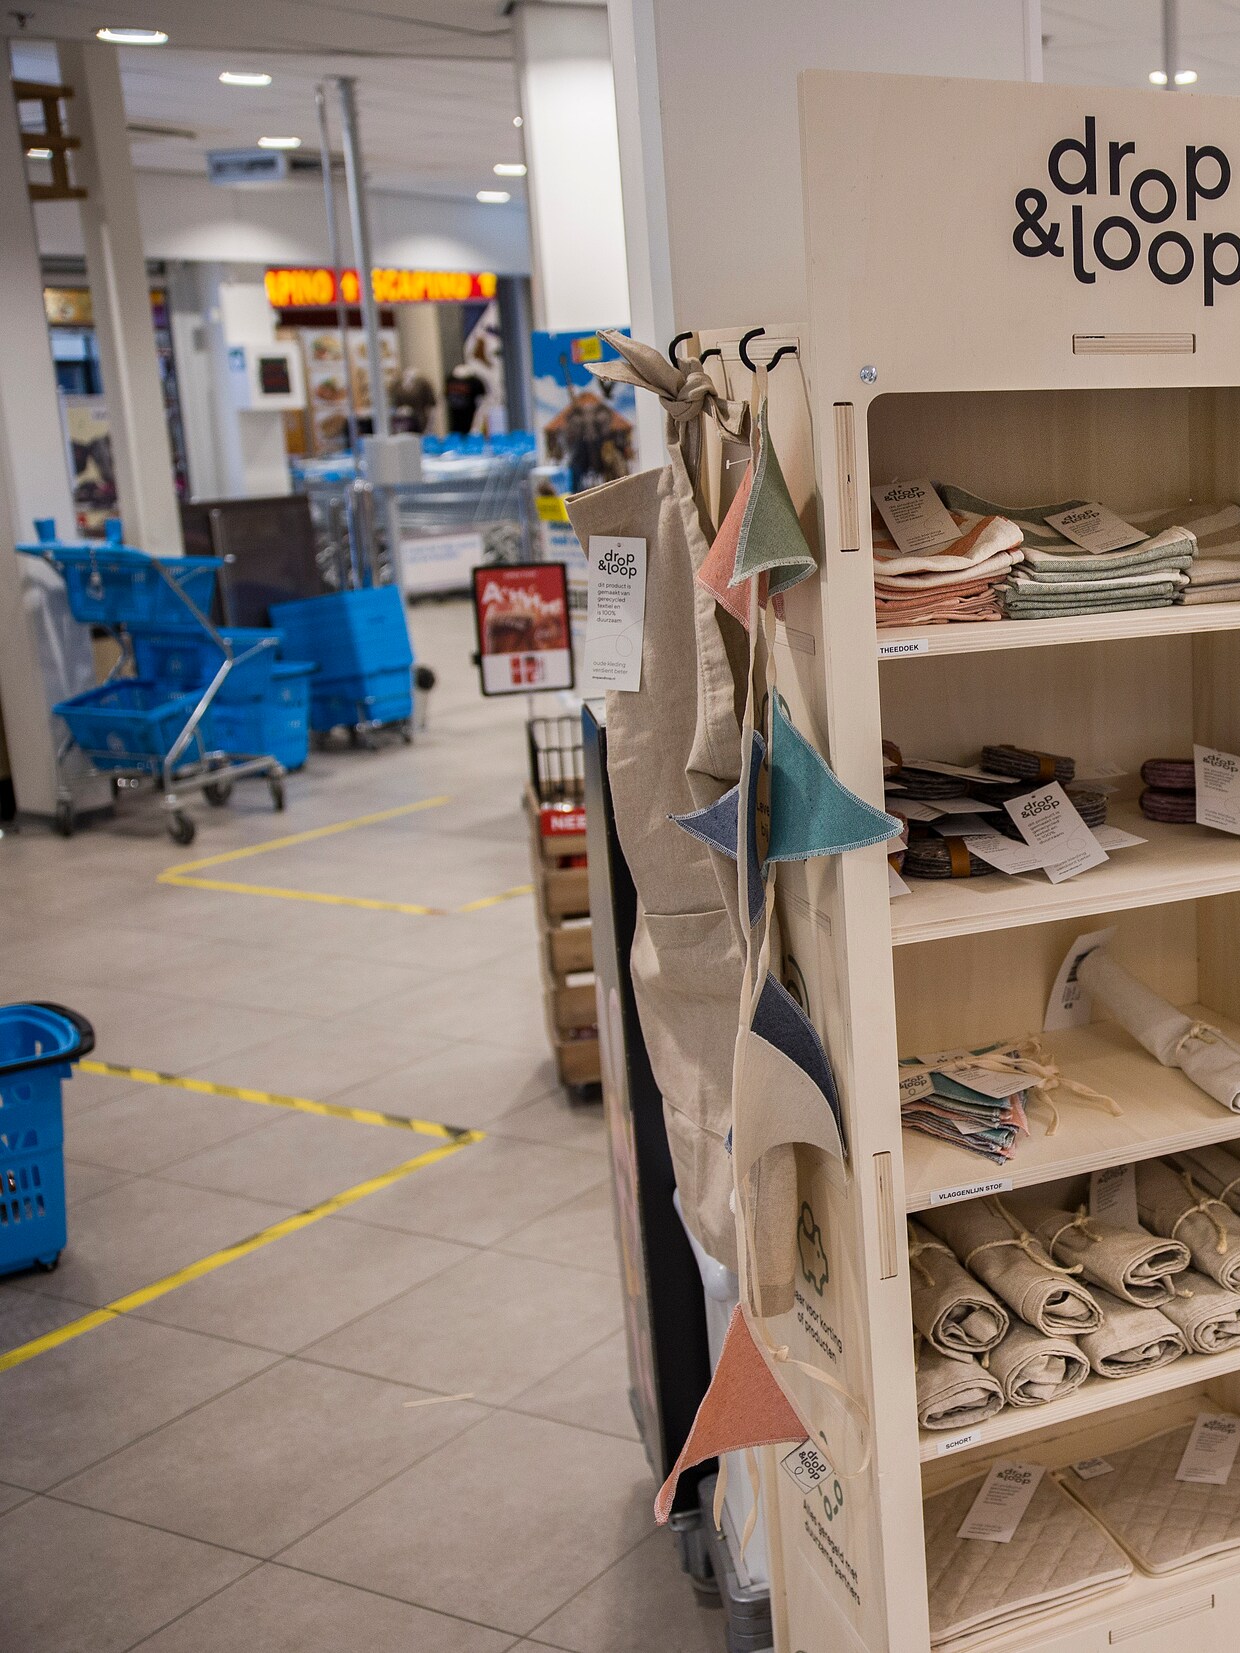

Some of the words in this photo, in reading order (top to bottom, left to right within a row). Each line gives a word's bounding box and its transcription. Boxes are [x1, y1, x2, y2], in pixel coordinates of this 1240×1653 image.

[1048, 116, 1230, 223] drop
[604, 549, 635, 566] drop
[598, 560, 637, 579] &loop
[880, 644, 919, 653] THEEDOEK
[1024, 795, 1053, 811] drop
[939, 1187, 984, 1200] VLAGGENLIJN
[985, 1183, 1003, 1191] STOF
[805, 1320, 837, 1365] producten
[820, 1314, 842, 1354] korting
[945, 1436, 972, 1449] SCHORT
[799, 1451, 820, 1480] &loop
[807, 1451, 826, 1472] drop
